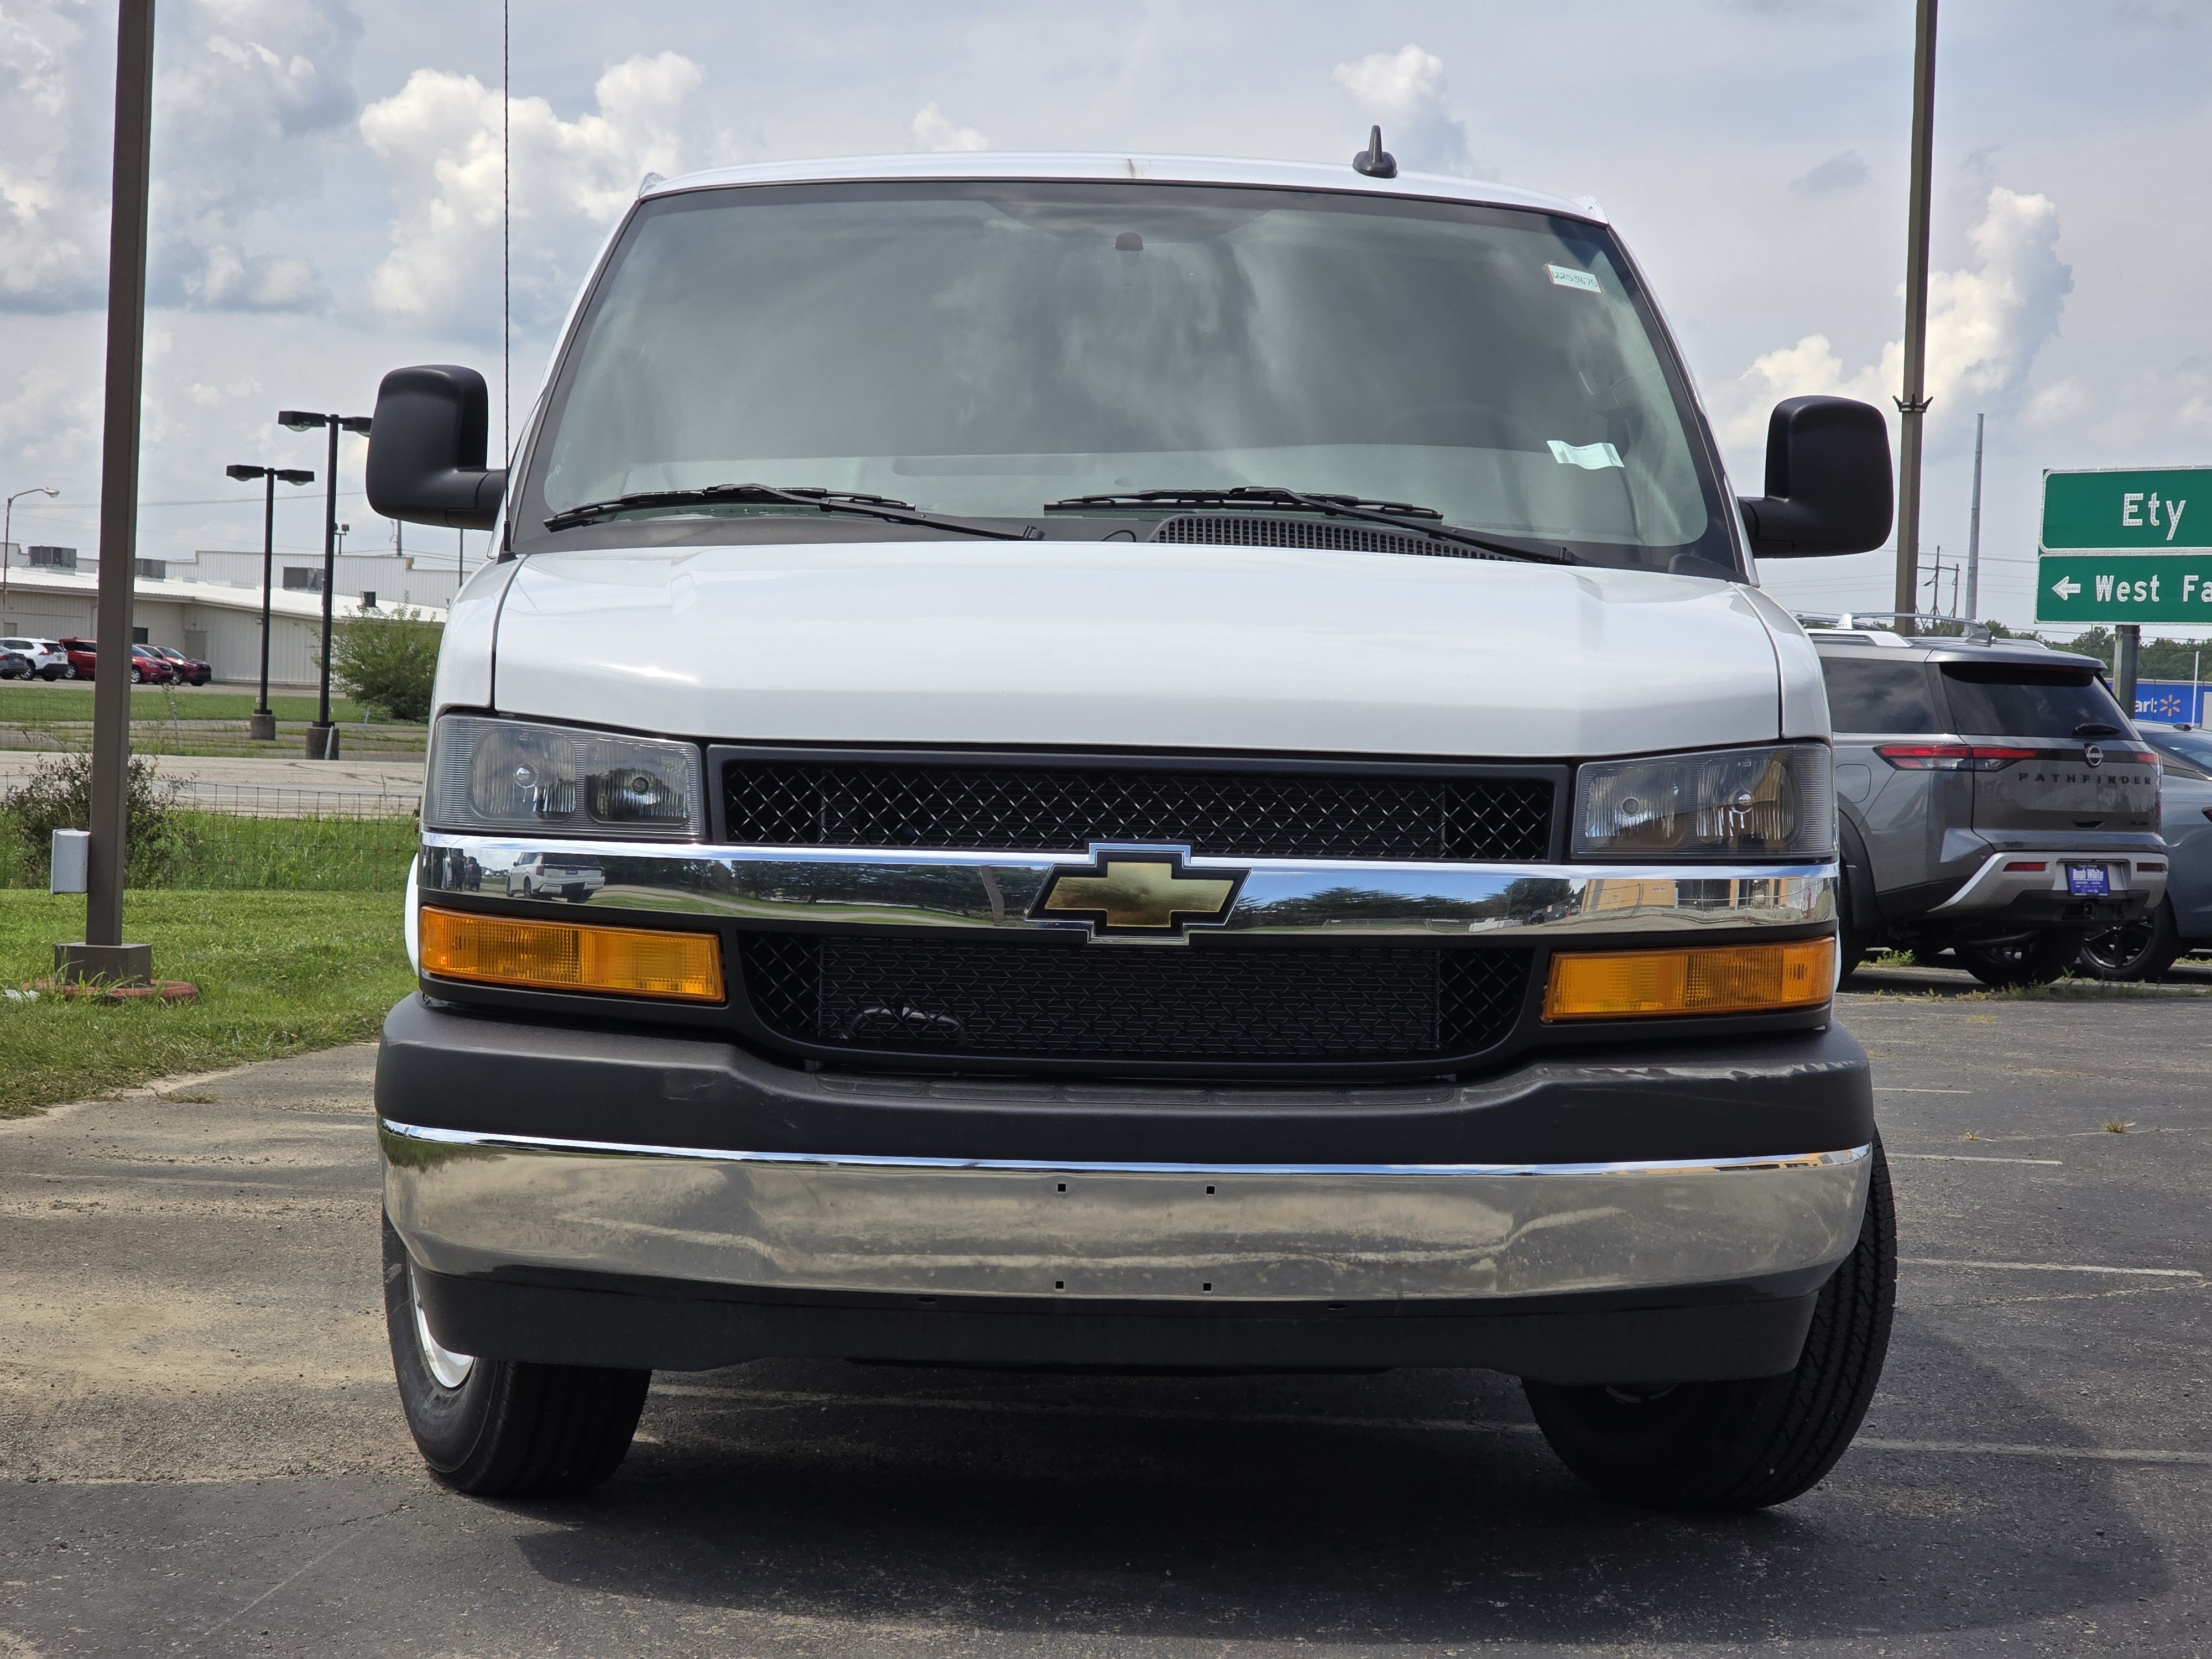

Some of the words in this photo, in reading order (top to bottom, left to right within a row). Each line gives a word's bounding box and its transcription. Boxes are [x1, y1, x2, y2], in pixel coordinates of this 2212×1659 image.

[2122, 492, 2186, 540] Ety
[2095, 575, 2159, 602] West
[2183, 575, 2212, 603] Fa
[2018, 773, 2151, 785] PATHFINDER
[2087, 868, 2104, 879] White
